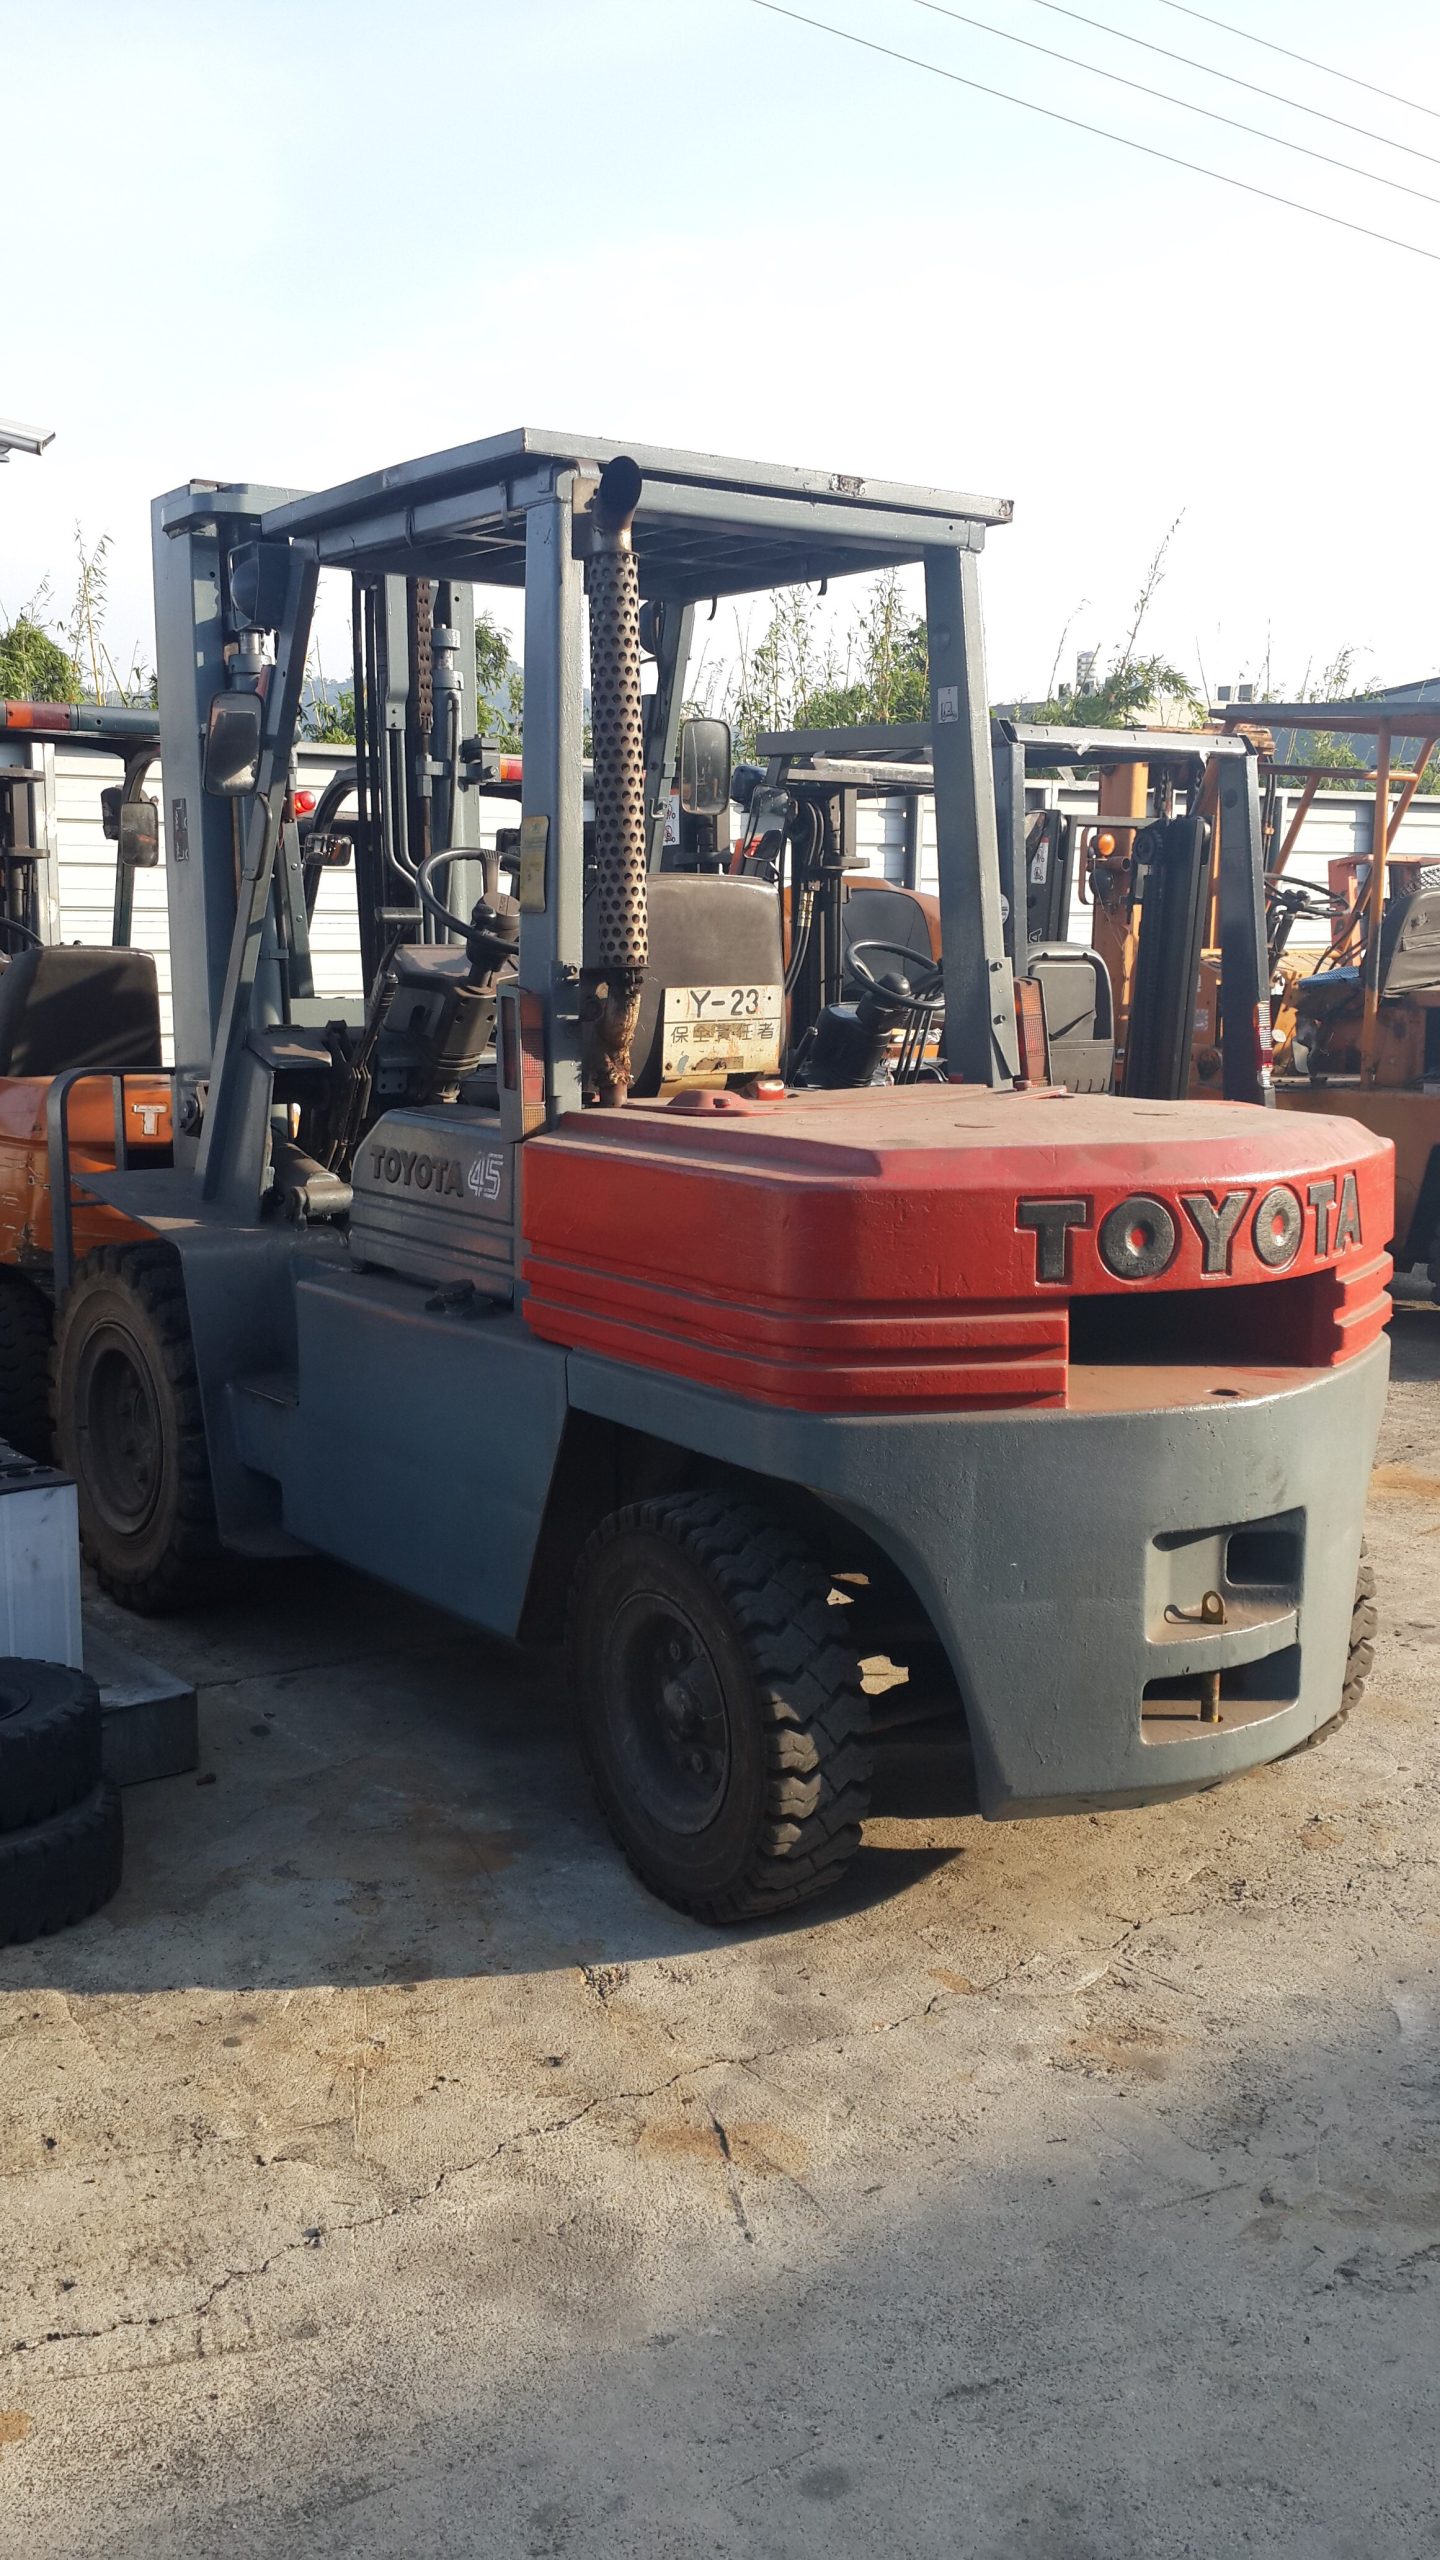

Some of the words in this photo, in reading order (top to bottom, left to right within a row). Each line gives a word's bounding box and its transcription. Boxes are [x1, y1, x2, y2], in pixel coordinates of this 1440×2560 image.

[690, 988, 760, 1018] Y-23
[370, 1144, 464, 1198] TOYOTA
[467, 1152, 504, 1200] 45
[1017, 1172, 1362, 1281] TOYOTA
